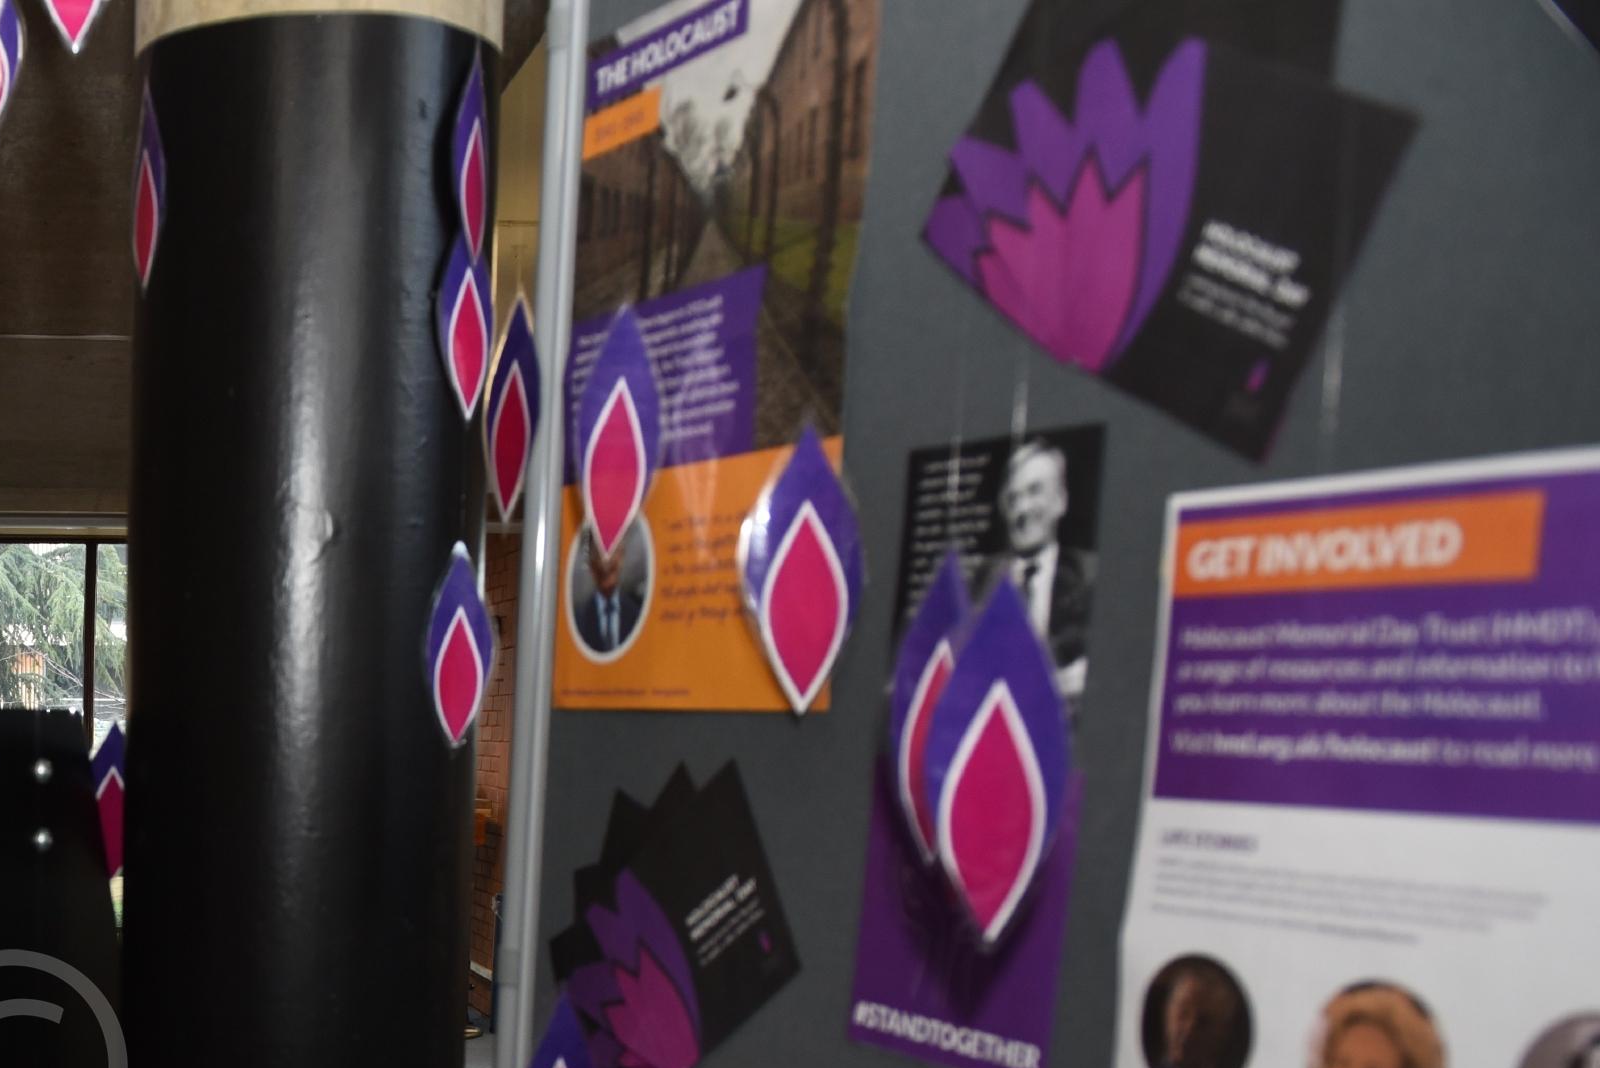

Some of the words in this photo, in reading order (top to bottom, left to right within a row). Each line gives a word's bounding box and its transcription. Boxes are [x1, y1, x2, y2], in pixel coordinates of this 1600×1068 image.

[596, 56, 630, 95] THE
[630, 0, 741, 80] HOLOCAUST
[1186, 534, 1257, 582] GET
[1256, 517, 1465, 576] INVOLVED
